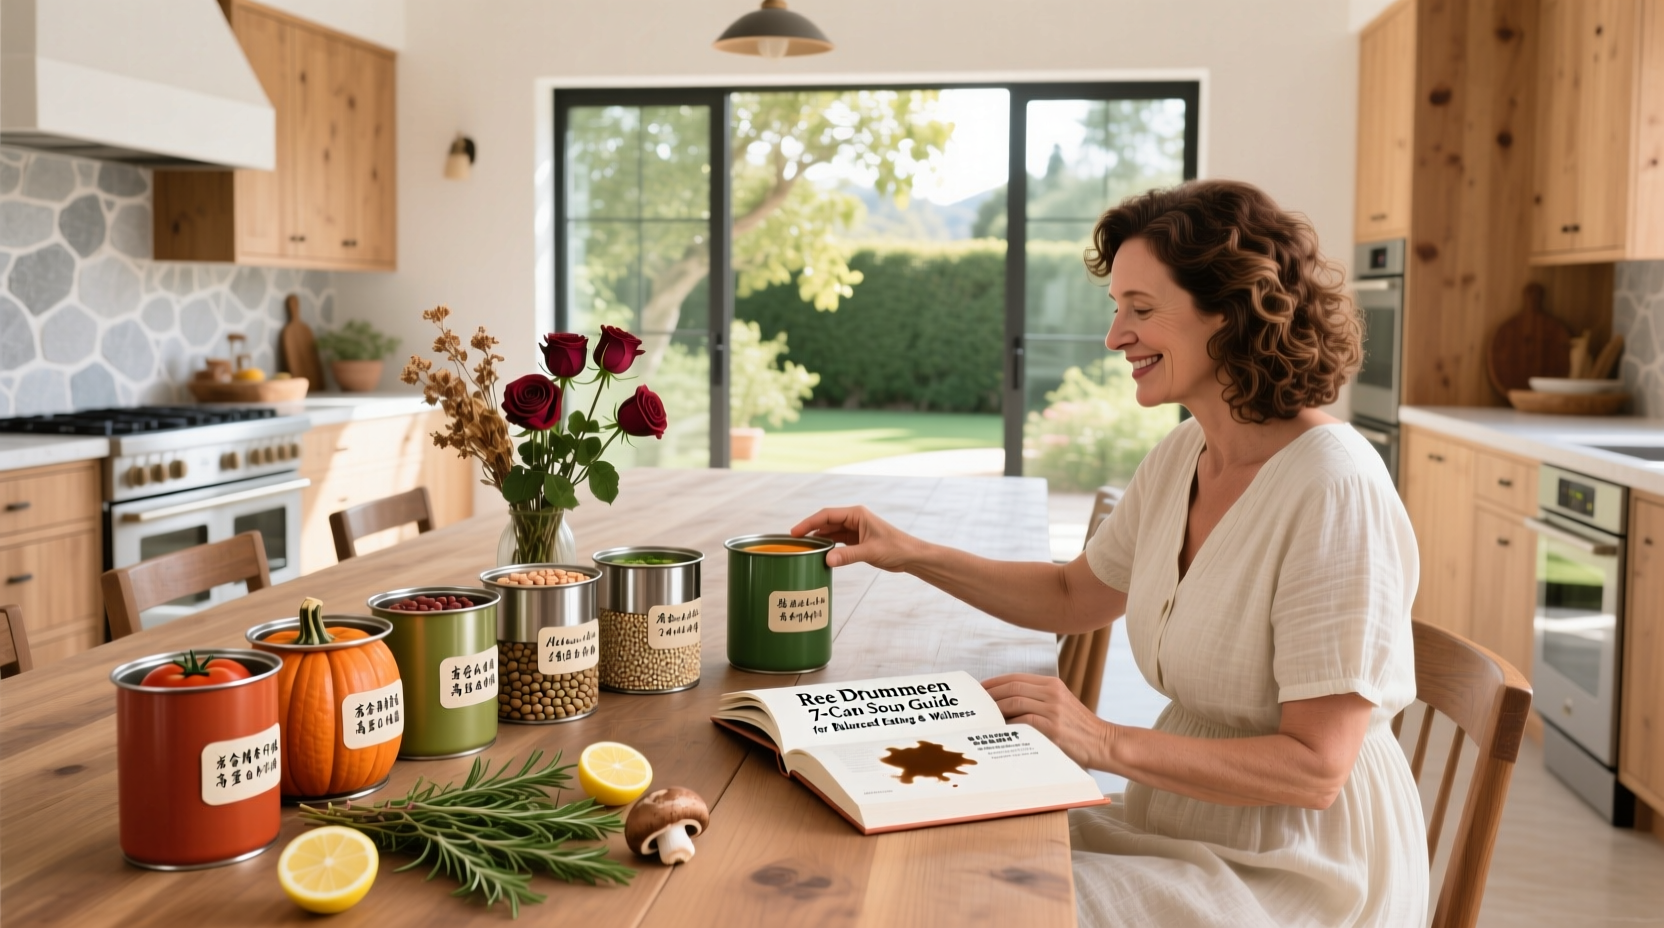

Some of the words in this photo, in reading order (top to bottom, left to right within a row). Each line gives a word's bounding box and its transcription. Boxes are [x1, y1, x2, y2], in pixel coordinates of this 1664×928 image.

[795, 692, 838, 707] Ree
[836, 682, 951, 702] Drummeen
[808, 705, 865, 722] 7-Can
[908, 693, 959, 710] Guide
[813, 725, 828, 735] for
